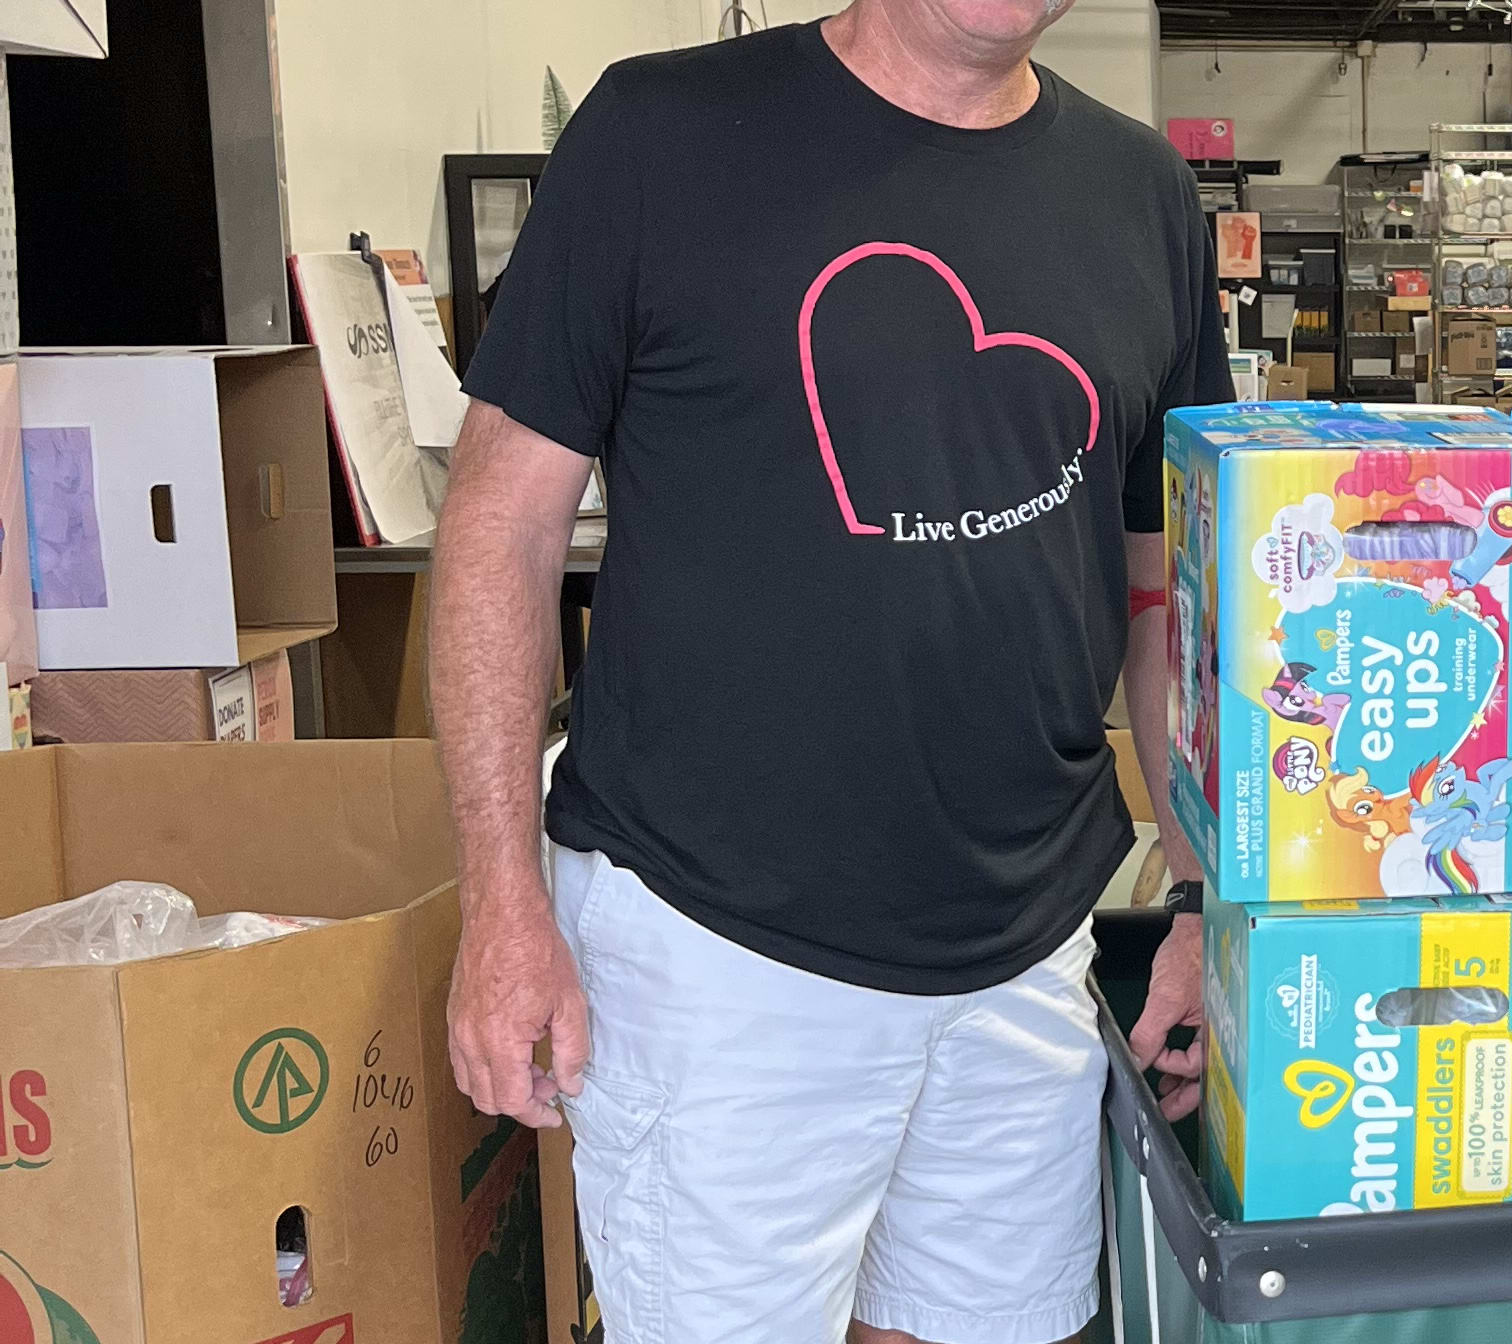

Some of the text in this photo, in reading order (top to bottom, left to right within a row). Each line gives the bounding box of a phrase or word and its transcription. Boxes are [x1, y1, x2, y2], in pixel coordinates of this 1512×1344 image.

[891, 512, 956, 541] Live
[1268, 547, 1280, 581] soft
[1326, 609, 1353, 686] Pampers
[1453, 638, 1467, 692] training
[1467, 627, 1477, 701] underwear
[1361, 635, 1403, 762] easy
[1405, 630, 1448, 729] ups
[218, 697, 245, 728] DONATE
[1251, 710, 1264, 766] FORMAT
[1236, 770, 1249, 798] SIZE
[1251, 767, 1264, 817] GRAND
[1290, 736, 1326, 795] PONY
[1236, 800, 1249, 860] LARGEST
[1251, 817, 1263, 852] PLUS
[1454, 957, 1486, 978] 5
[1303, 959, 1314, 1043] PEDIATRICIAN
[364, 1029, 382, 1068] 6
[1474, 1046, 1486, 1110] LEAKPROOF
[0, 1068, 52, 1156] S
[1319, 992, 1413, 1217] amper
[1426, 1037, 1456, 1195] swaddlers
[1487, 1043, 1508, 1186] skin protection
[365, 1125, 398, 1167] 60
